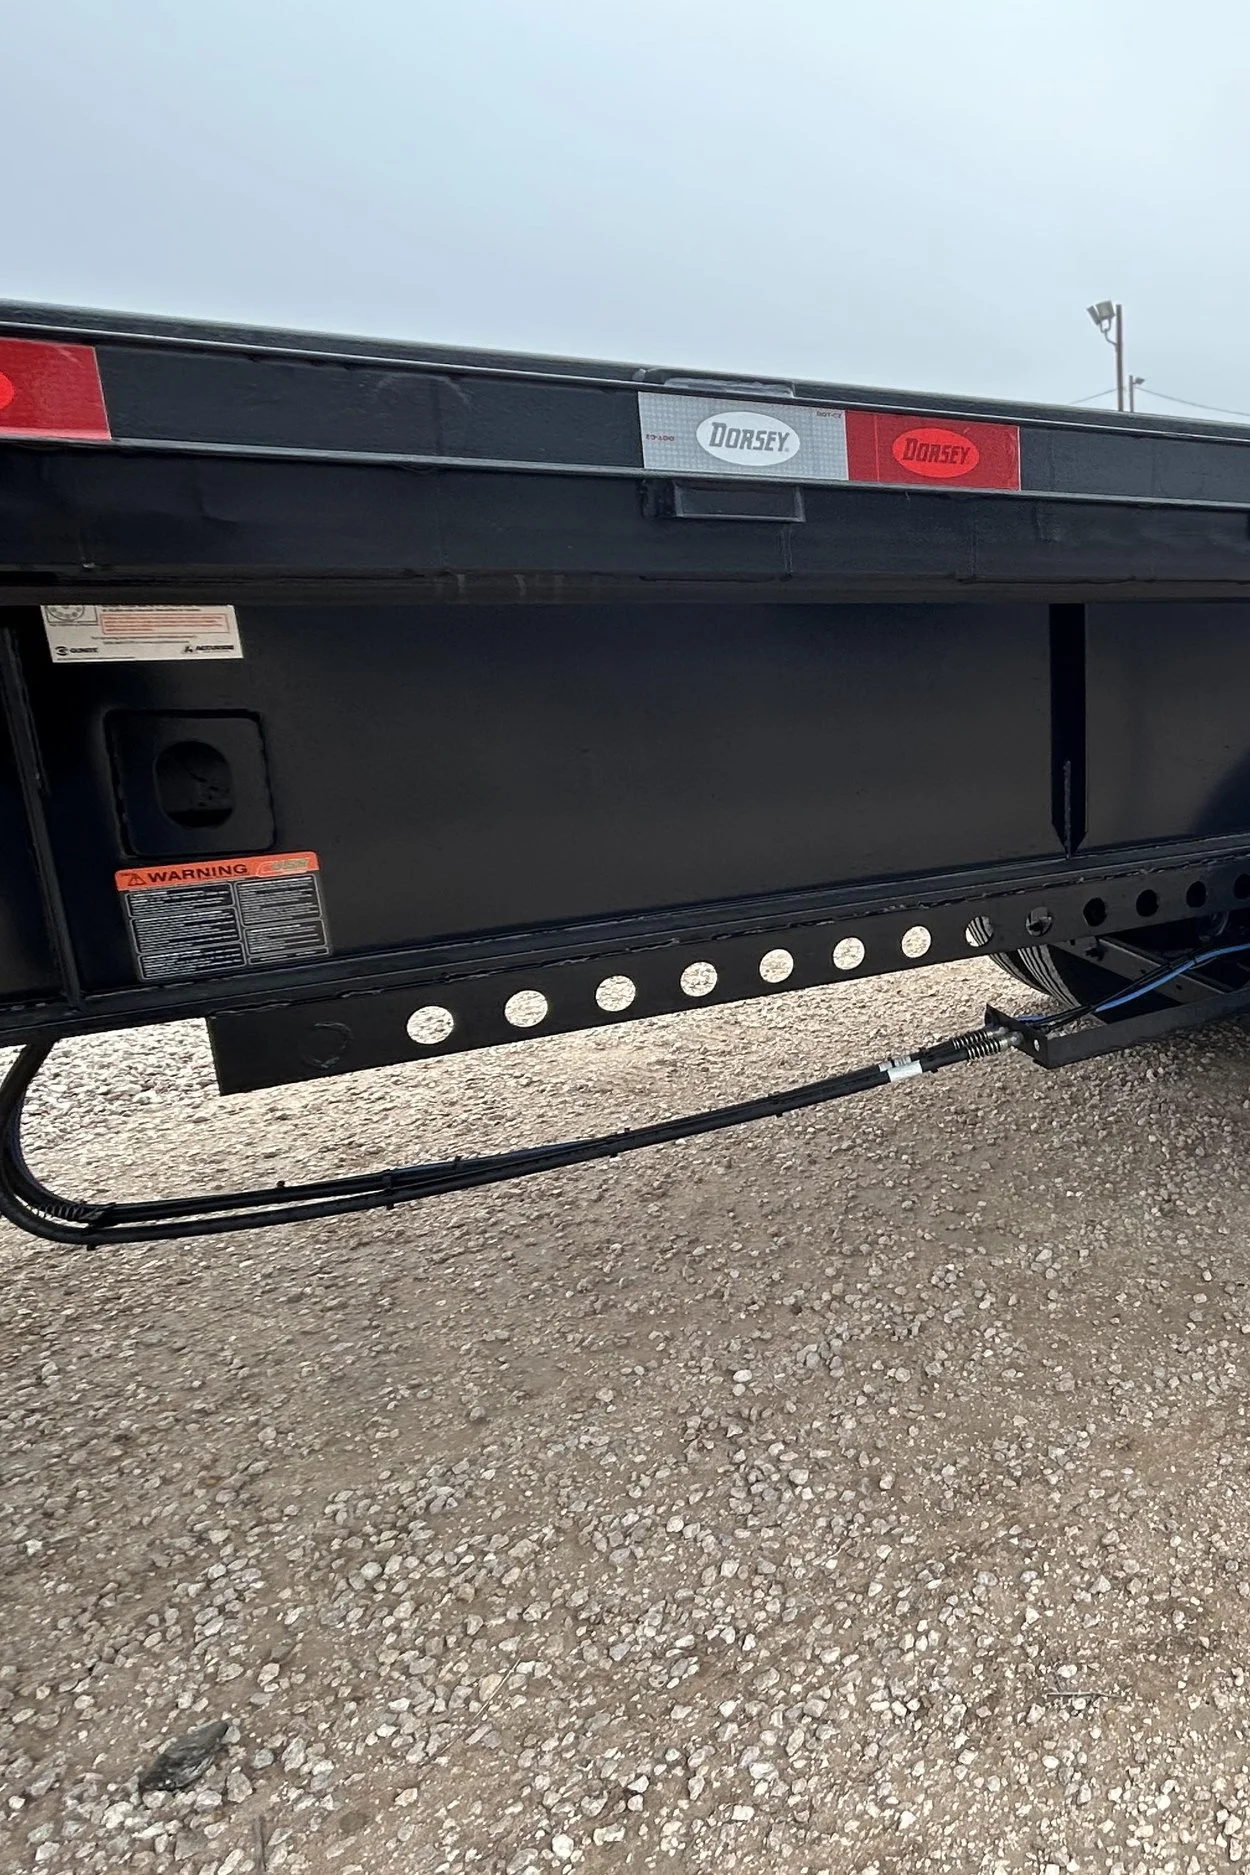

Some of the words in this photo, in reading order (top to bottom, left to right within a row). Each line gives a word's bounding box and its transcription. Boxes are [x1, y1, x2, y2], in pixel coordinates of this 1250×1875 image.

[709, 422, 790, 452] DORSEY
[903, 437, 971, 465] DORSEY
[147, 864, 248, 883] WARNING
